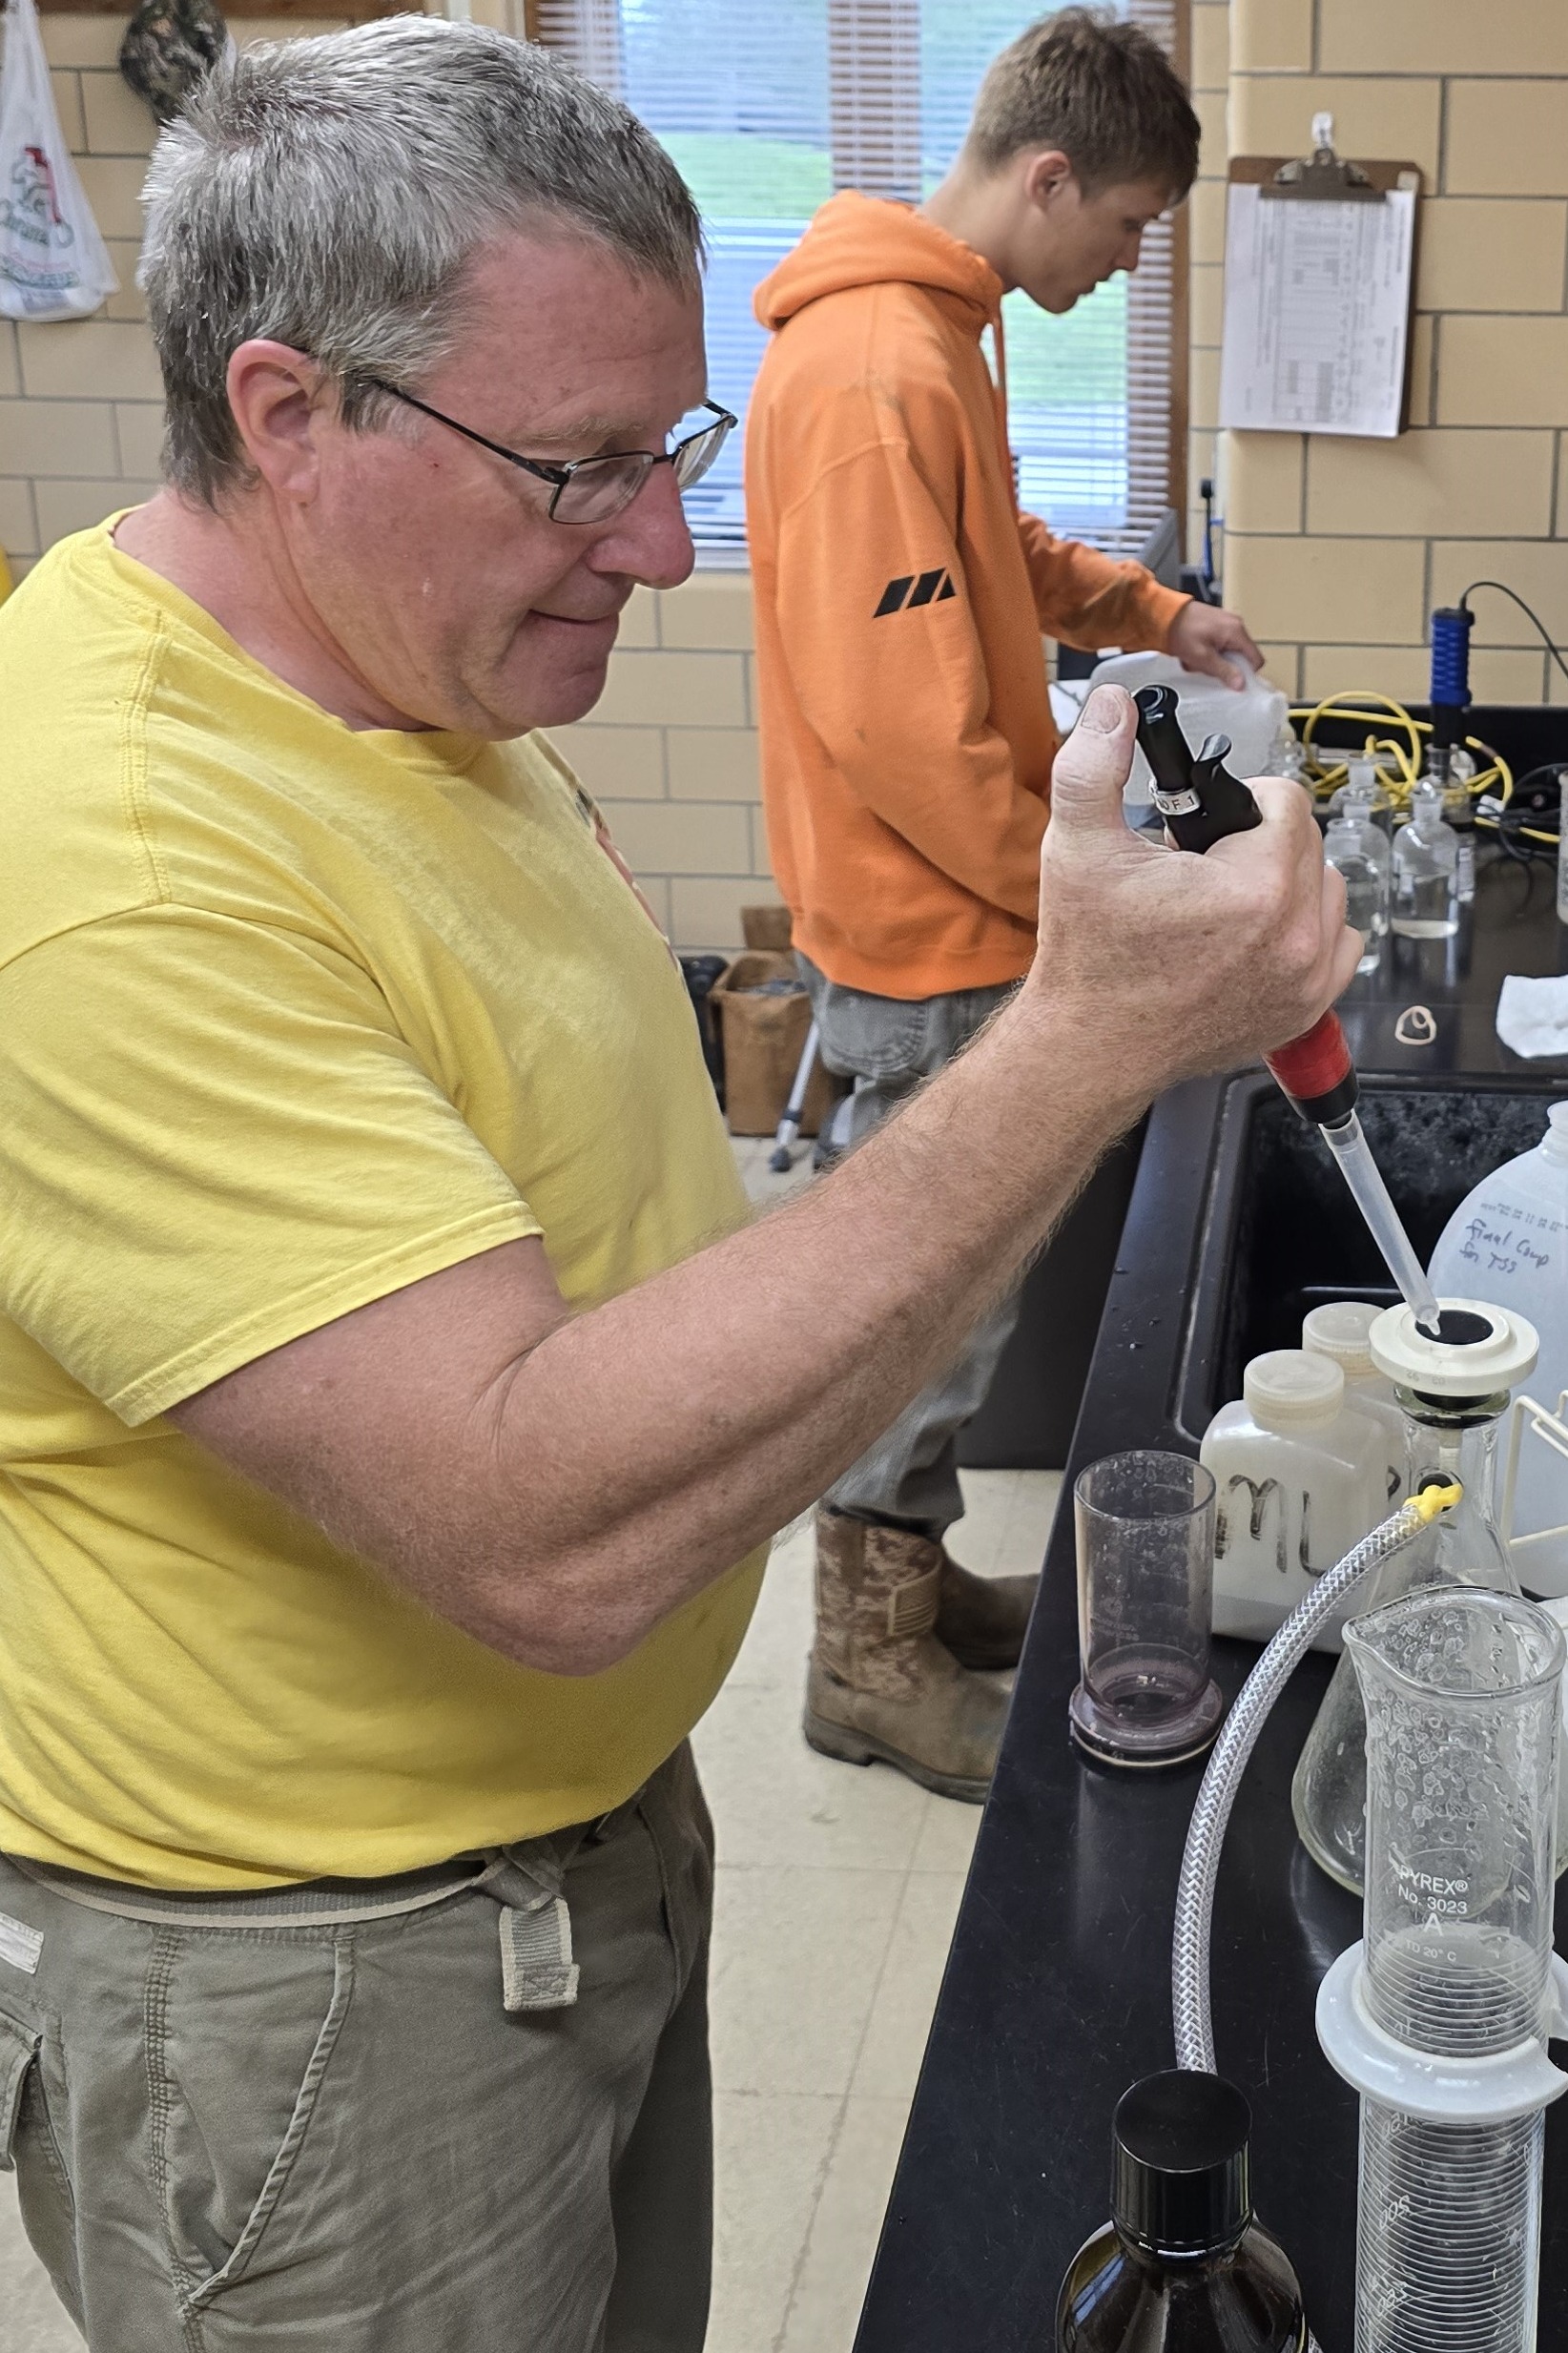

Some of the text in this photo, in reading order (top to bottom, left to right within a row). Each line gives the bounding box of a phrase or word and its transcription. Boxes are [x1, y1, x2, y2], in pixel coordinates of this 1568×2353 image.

[1397, 1883, 1469, 1915] No. 3023
[1422, 1912, 1444, 1937] A
[1405, 1938, 1421, 1953] TD
